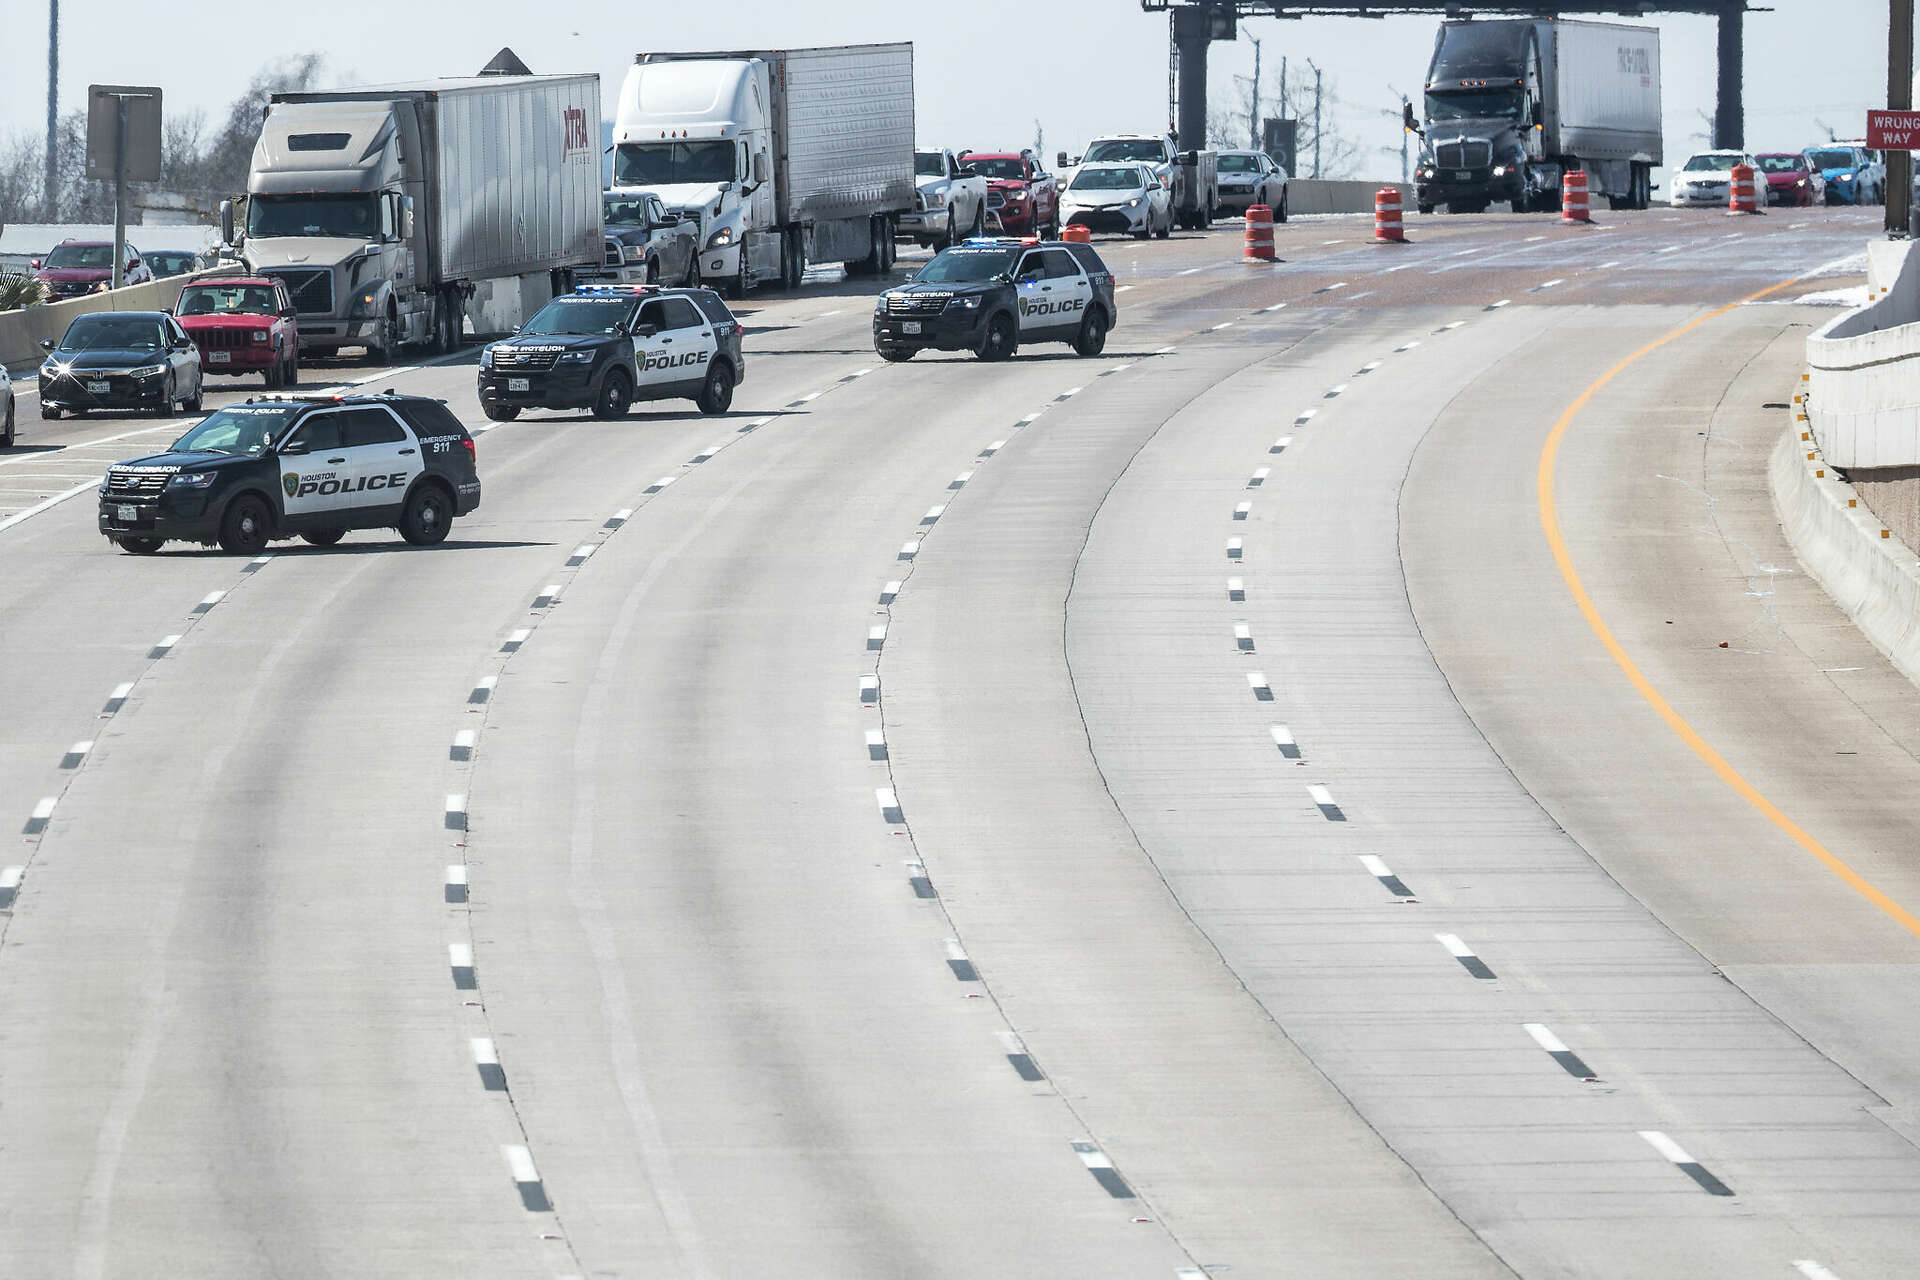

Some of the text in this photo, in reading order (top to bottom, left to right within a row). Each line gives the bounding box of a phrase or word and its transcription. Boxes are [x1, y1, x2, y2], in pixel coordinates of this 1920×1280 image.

[1874, 116, 1920, 130] WRONG
[1882, 132, 1911, 145] WAY
[1026, 298, 1084, 317] POLICE
[720, 326, 731, 337] 911
[644, 350, 708, 372] POLICE
[419, 433, 462, 445] EMERGENCY
[433, 441, 450, 453] 911
[300, 471, 337, 482] HOUSTON
[296, 471, 408, 498] POLICE
